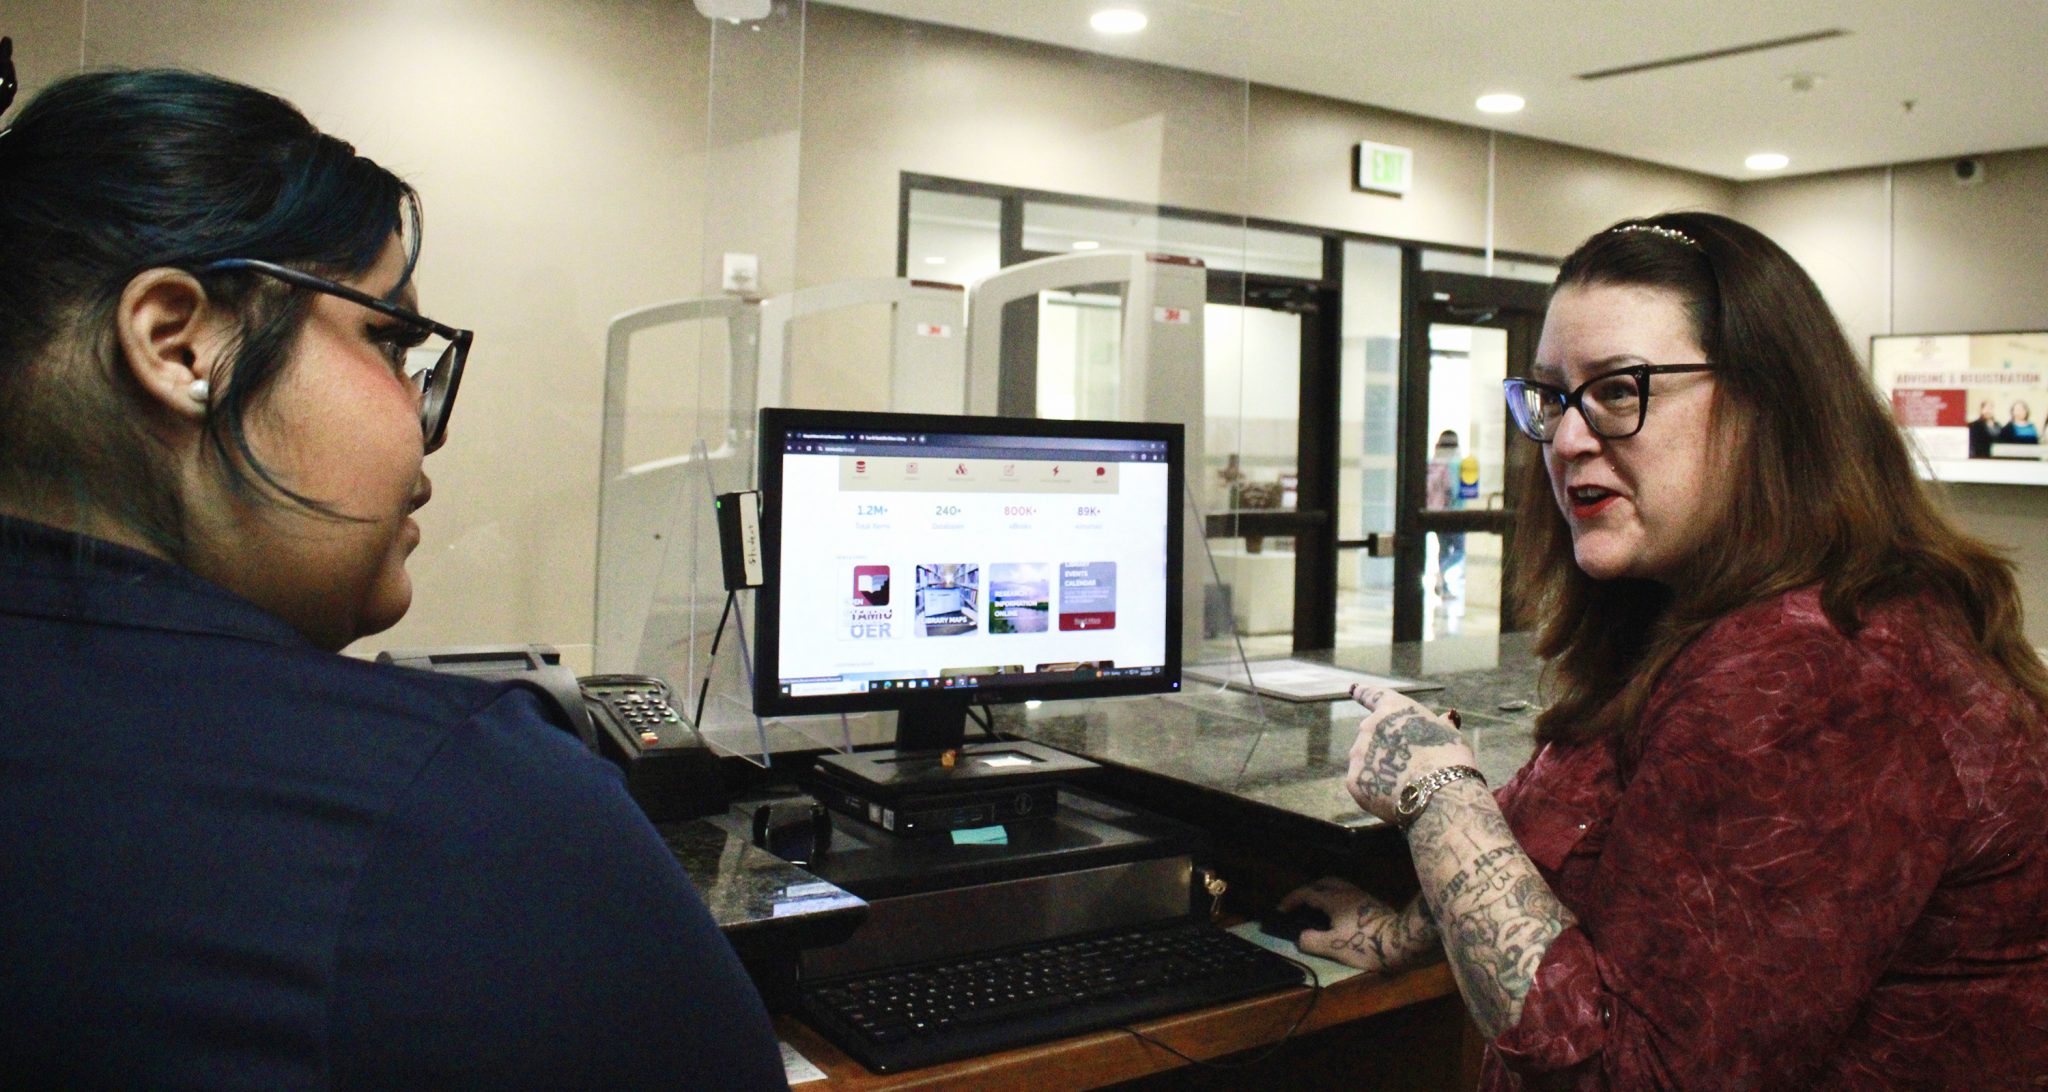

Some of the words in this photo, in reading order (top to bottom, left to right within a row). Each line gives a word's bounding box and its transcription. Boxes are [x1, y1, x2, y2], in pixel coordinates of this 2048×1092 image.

[1960, 372, 2041, 384] REGISTRATION
[935, 505, 962, 516] 240+
[1004, 505, 1037, 516] 800K+
[1077, 505, 1101, 517] 89K+
